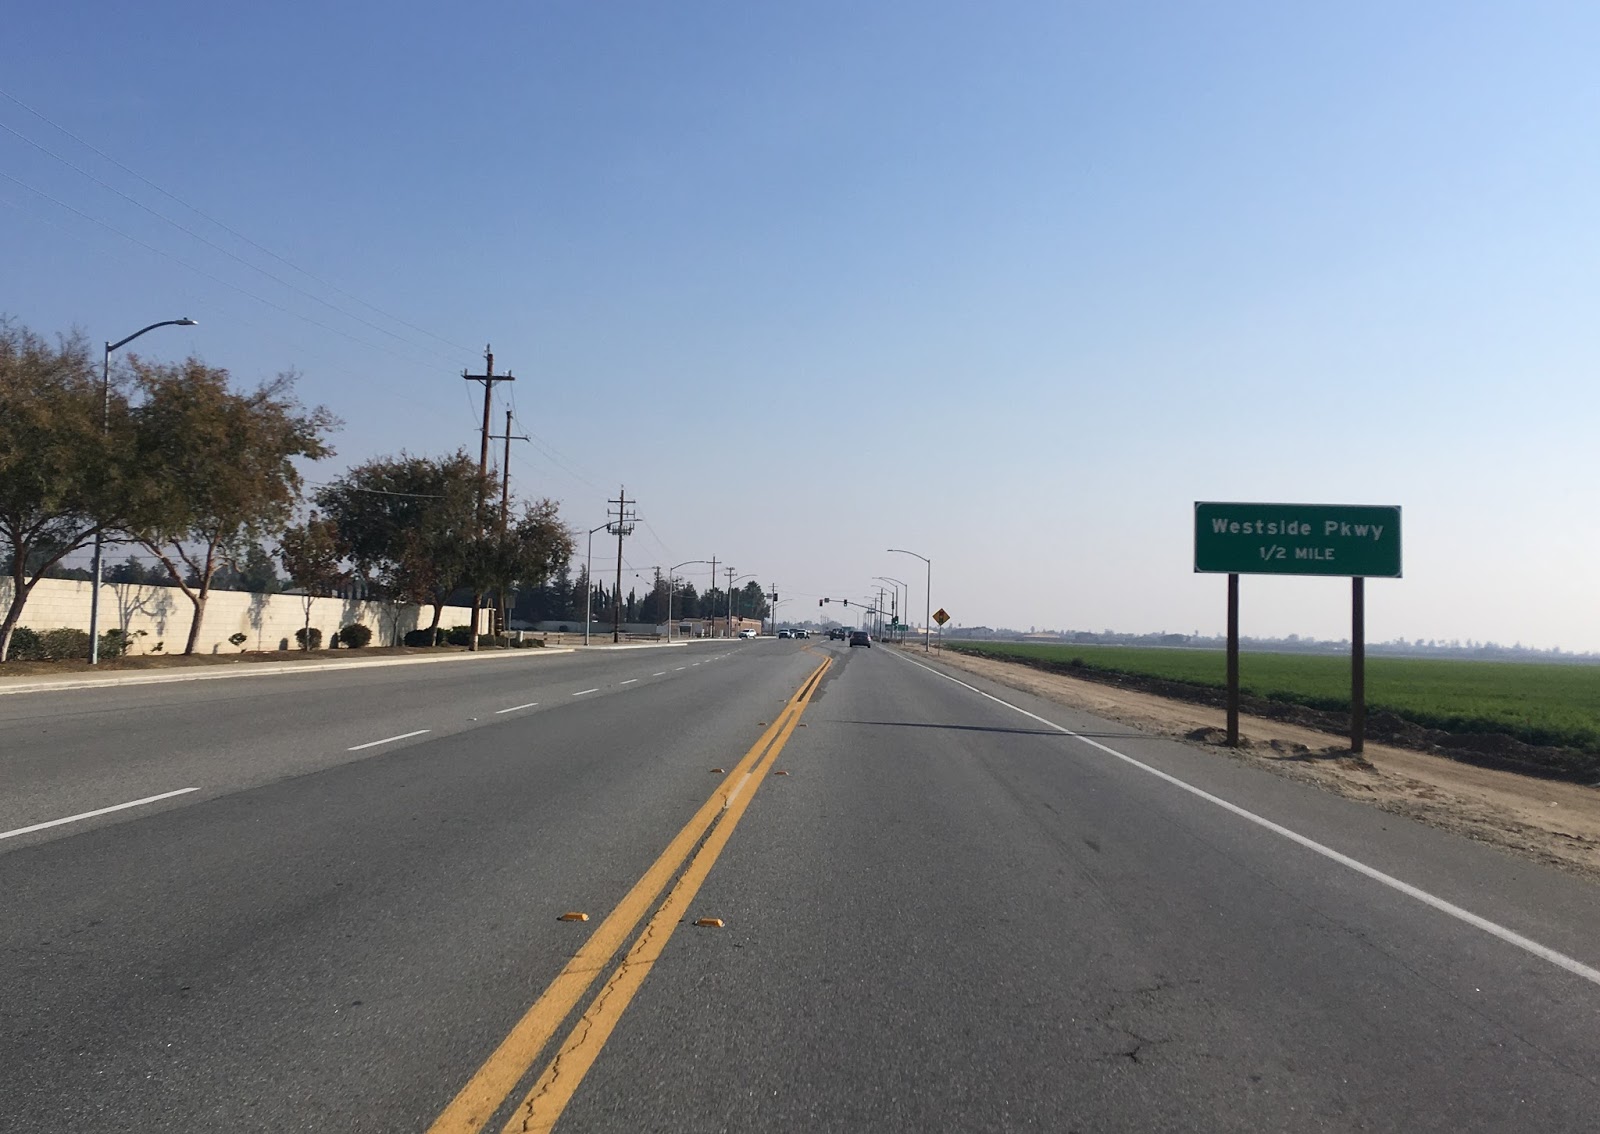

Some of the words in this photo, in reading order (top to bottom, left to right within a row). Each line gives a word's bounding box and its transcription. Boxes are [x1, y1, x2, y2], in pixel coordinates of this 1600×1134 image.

[1212, 518, 1312, 536] Westside
[1324, 520, 1384, 541] Pkwy
[1259, 545, 1286, 560] 1/2
[1295, 548, 1335, 560] MILE
